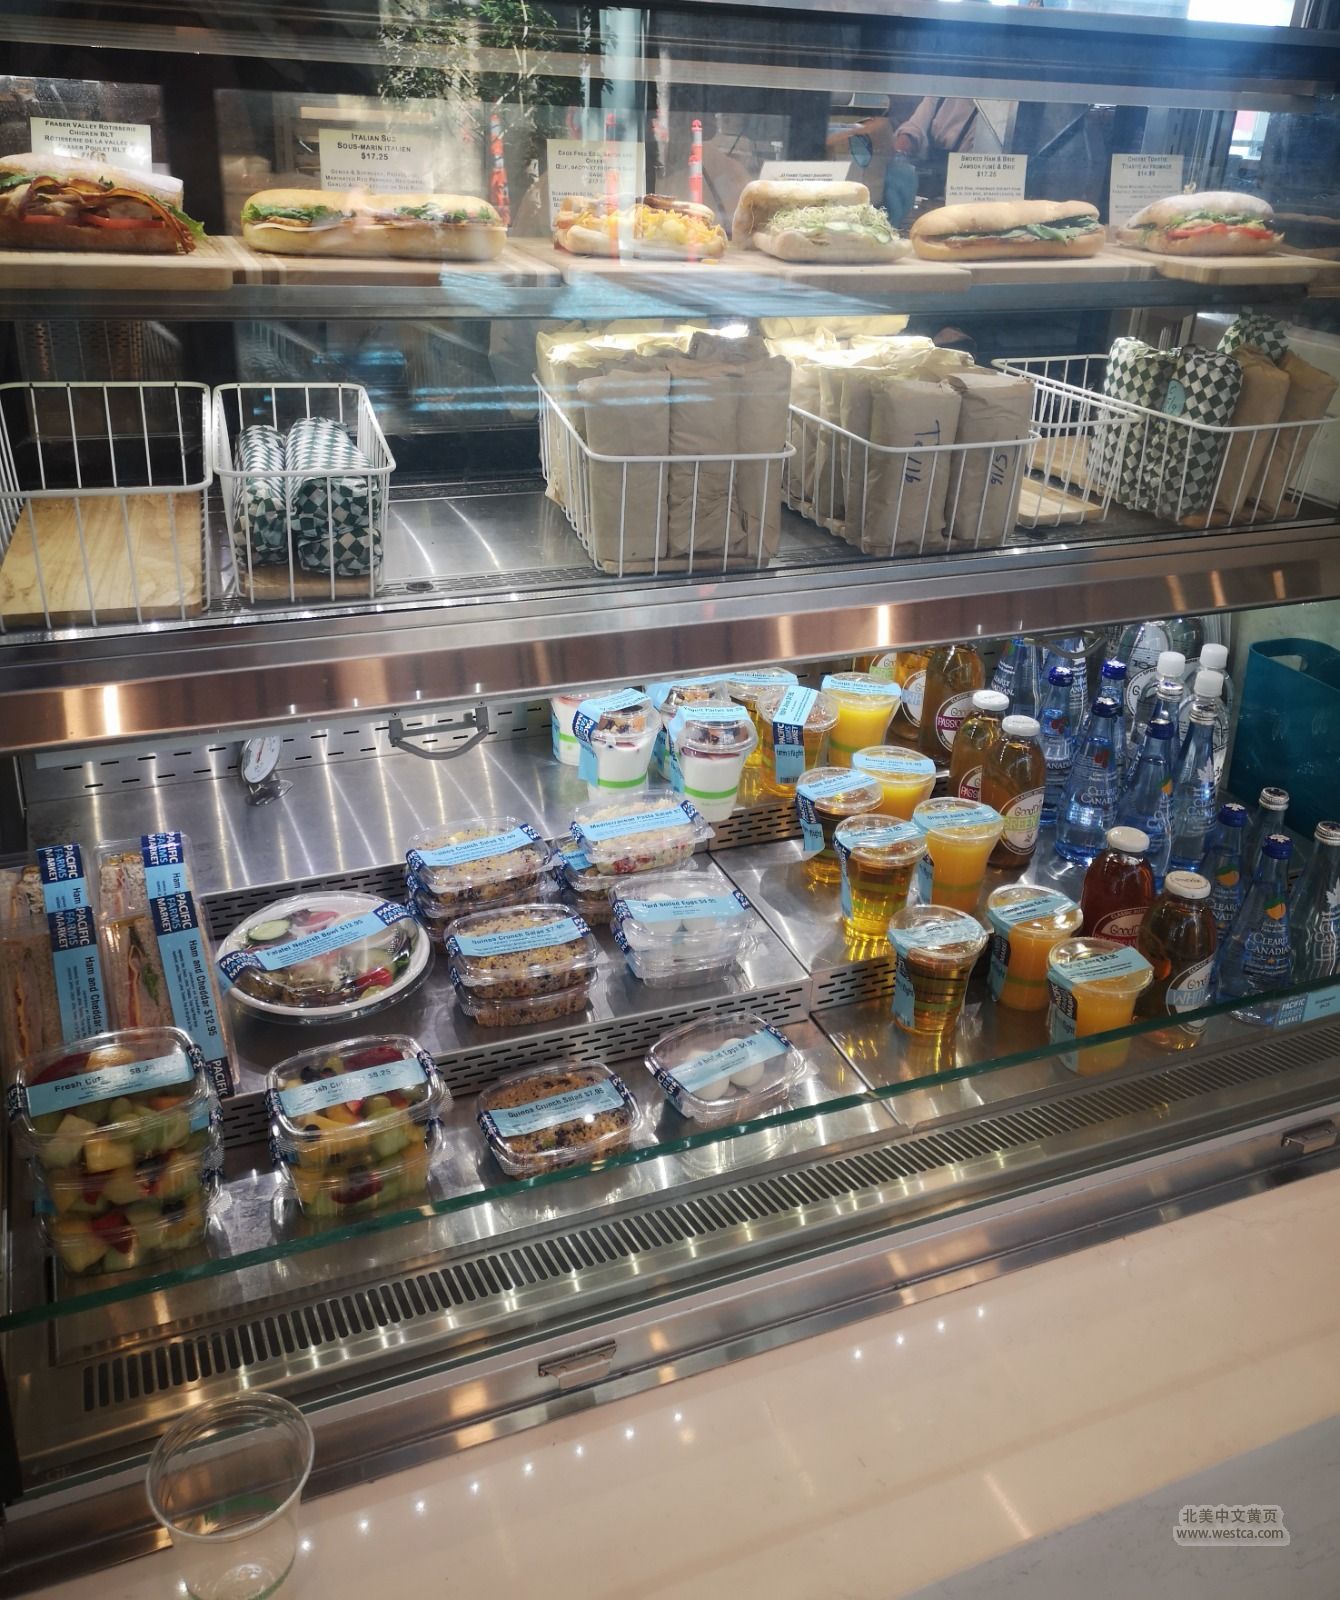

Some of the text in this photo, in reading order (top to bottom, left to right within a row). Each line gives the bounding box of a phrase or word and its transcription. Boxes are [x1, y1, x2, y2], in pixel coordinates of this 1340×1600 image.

[44, 135, 83, 144] ROTISSERIE
[69, 129, 98, 137] CHICKEN
[73, 122, 97, 130] VALLEY
[99, 123, 137, 132] ROTISSERIE
[351, 133, 379, 142] ITALIAN
[337, 142, 411, 153] SOUS-MARIN ITALIEN
[361, 152, 389, 161] $17.25
[63, 844, 79, 879] PACIFIC
[147, 834, 159, 866] MARKET
[156, 833, 168, 863] FARMS
[167, 831, 179, 863] PACIFIC
[45, 848, 58, 882] MARKET
[54, 848, 67, 880] FARMS
[72, 887, 83, 905] Ham
[176, 893, 192, 929] PACIFIC
[65, 911, 79, 946] FARMS
[76, 907, 91, 946] PACIFIC
[157, 897, 172, 932] MARKET
[167, 897, 181, 930] FARMS
[55, 911, 69, 949] MARKET
[321, 927, 339, 941] Bowl
[86, 955, 103, 1028] Ham and Cheddar
[189, 939, 218, 1037] Ham and Cheddar $12.95
[54, 1080, 82, 1093] Fresh
[213, 1059, 229, 1098] PACIFIC
[508, 1087, 605, 1119] Quinoa Crunch Salad $7.95
